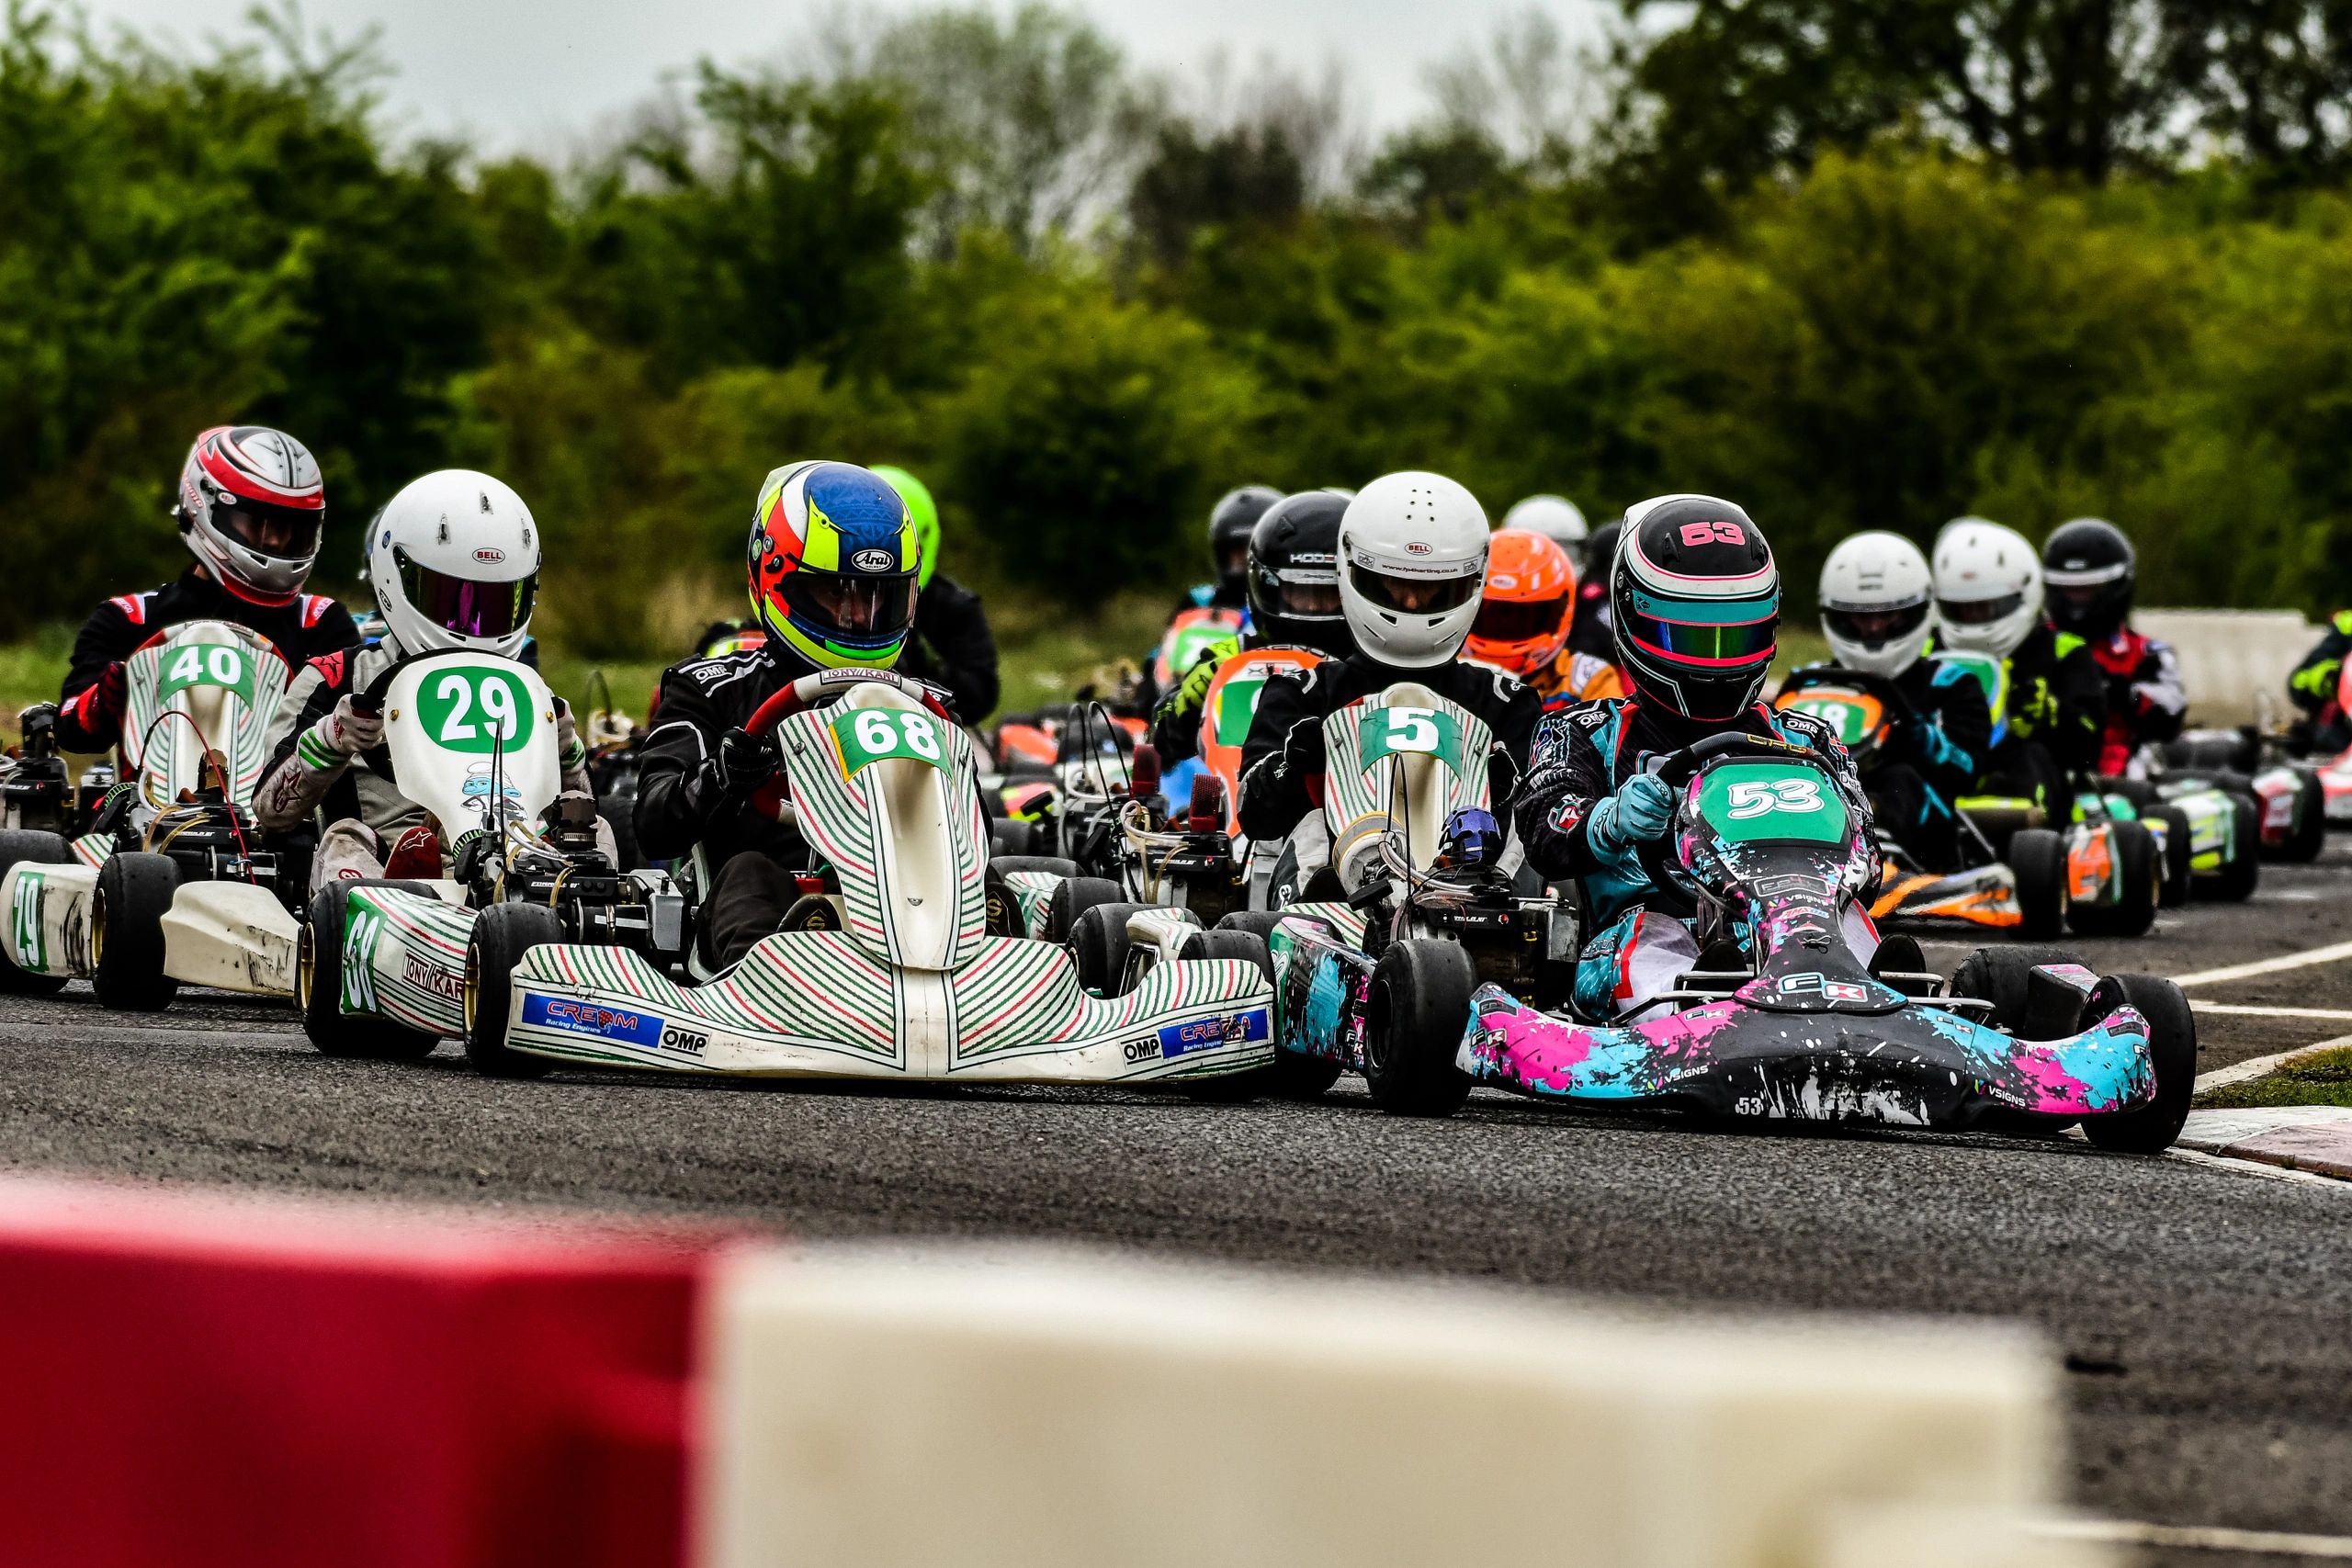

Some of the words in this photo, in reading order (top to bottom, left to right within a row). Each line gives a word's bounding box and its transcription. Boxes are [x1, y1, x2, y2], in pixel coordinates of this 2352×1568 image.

[1679, 522, 1746, 547] 53
[477, 551, 502, 559] BELL
[856, 551, 889, 567] Arai
[169, 646, 242, 684] 40
[436, 675, 517, 741] 29
[854, 710, 941, 761] 68
[1385, 706, 1439, 751] 5
[1787, 721, 1818, 735] OMP
[1727, 779, 1825, 819] 53
[14, 875, 39, 967] 29
[405, 955, 429, 985] TONY
[545, 1018, 570, 1030] Racing
[571, 1022, 602, 1034] Engines
[662, 1030, 707, 1052] OMP
[1124, 1039, 1159, 1060] OMP
[1183, 1043, 1203, 1053] Racing
[1665, 1064, 1709, 1083] VSIGNS
[1738, 1097, 1761, 1115] 53
[1988, 1085, 2026, 1108] VSIGNS
